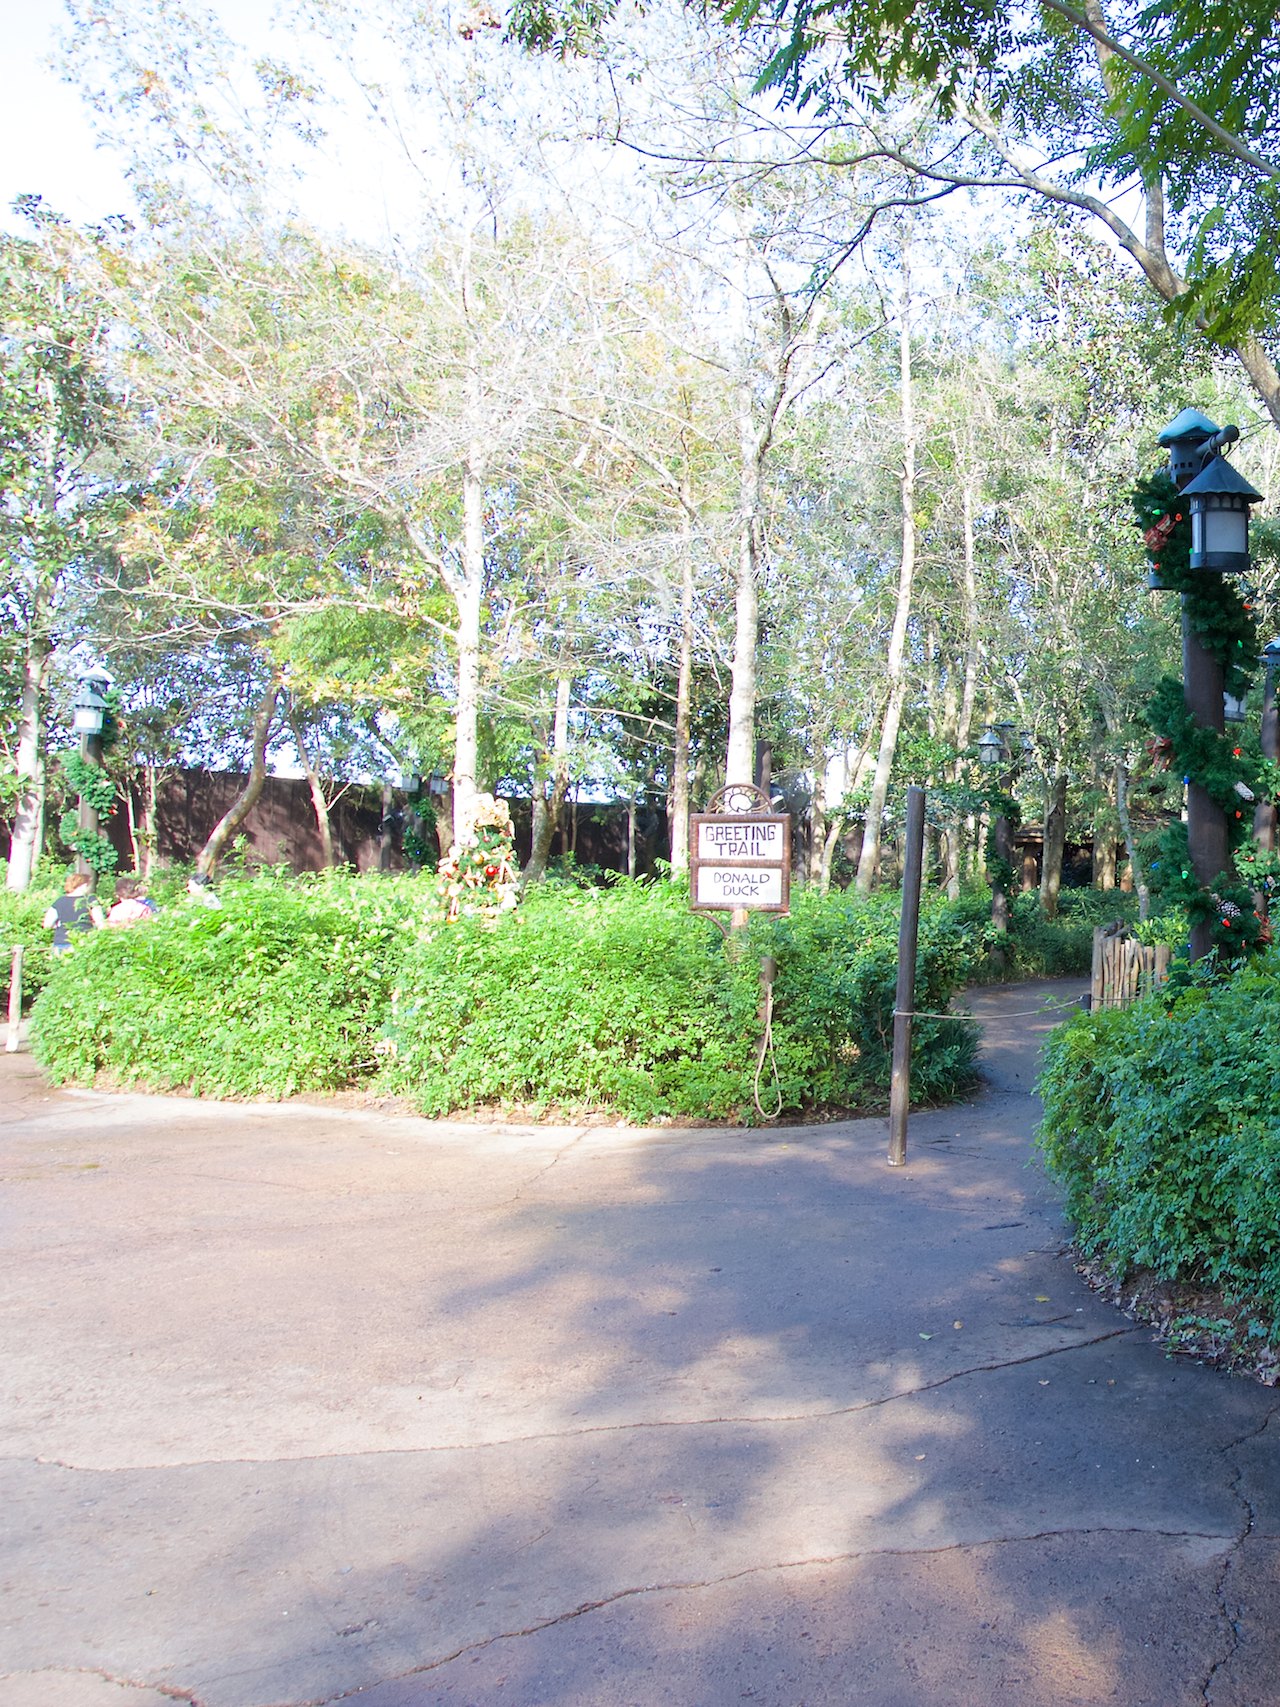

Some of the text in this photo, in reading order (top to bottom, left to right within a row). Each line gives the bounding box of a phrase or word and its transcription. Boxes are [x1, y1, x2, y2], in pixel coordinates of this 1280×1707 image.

[706, 825, 776, 841] GREETING
[714, 842, 766, 856] TRAIL
[714, 872, 770, 883] DONALD
[723, 885, 759, 896] DUCK
